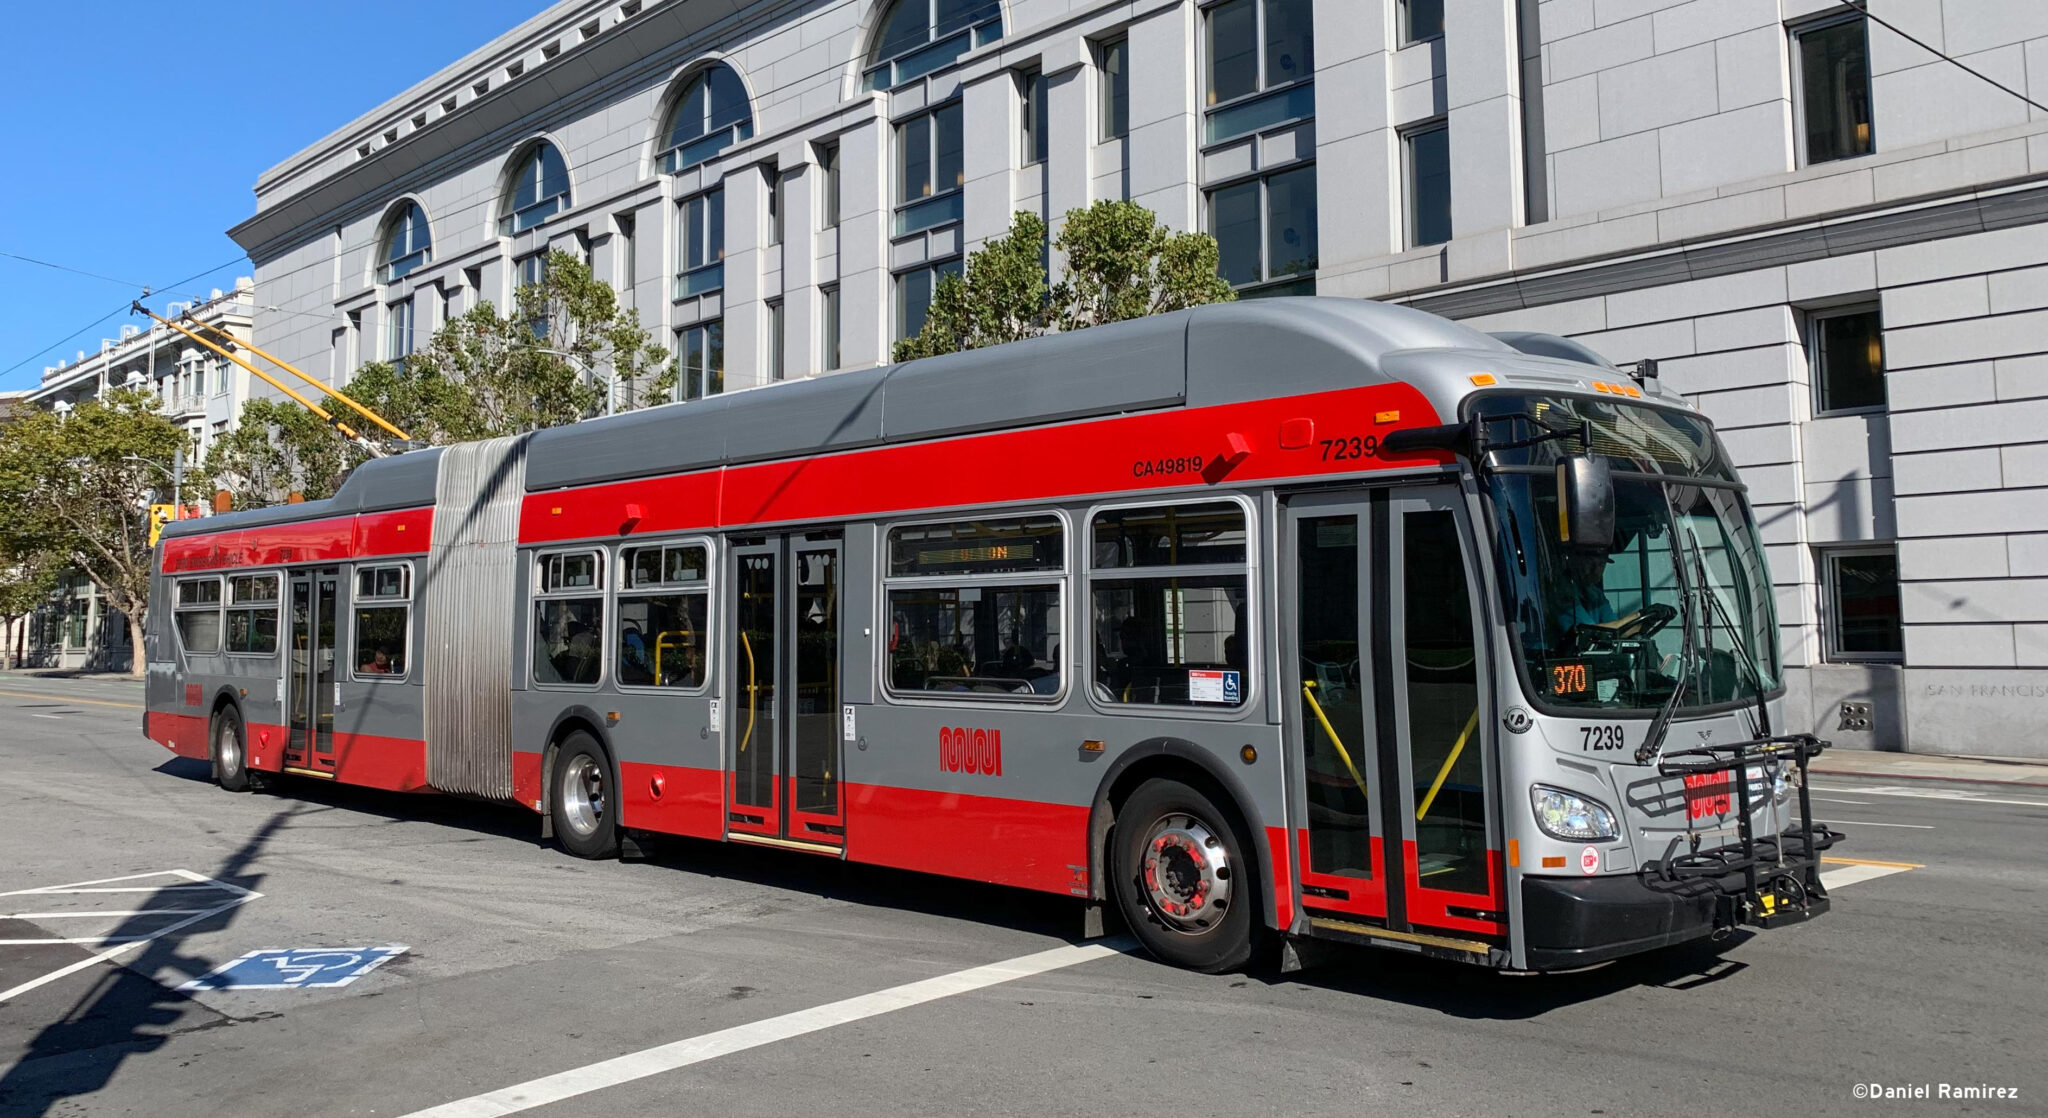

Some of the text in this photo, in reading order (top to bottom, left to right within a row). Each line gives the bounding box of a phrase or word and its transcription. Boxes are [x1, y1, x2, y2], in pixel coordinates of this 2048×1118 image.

[1320, 435, 1378, 461] 7239
[1133, 456, 1203, 477] CA49819
[1553, 664, 1587, 694] 370
[1927, 684, 1963, 698] SAN
[1580, 725, 1624, 751] 7239
